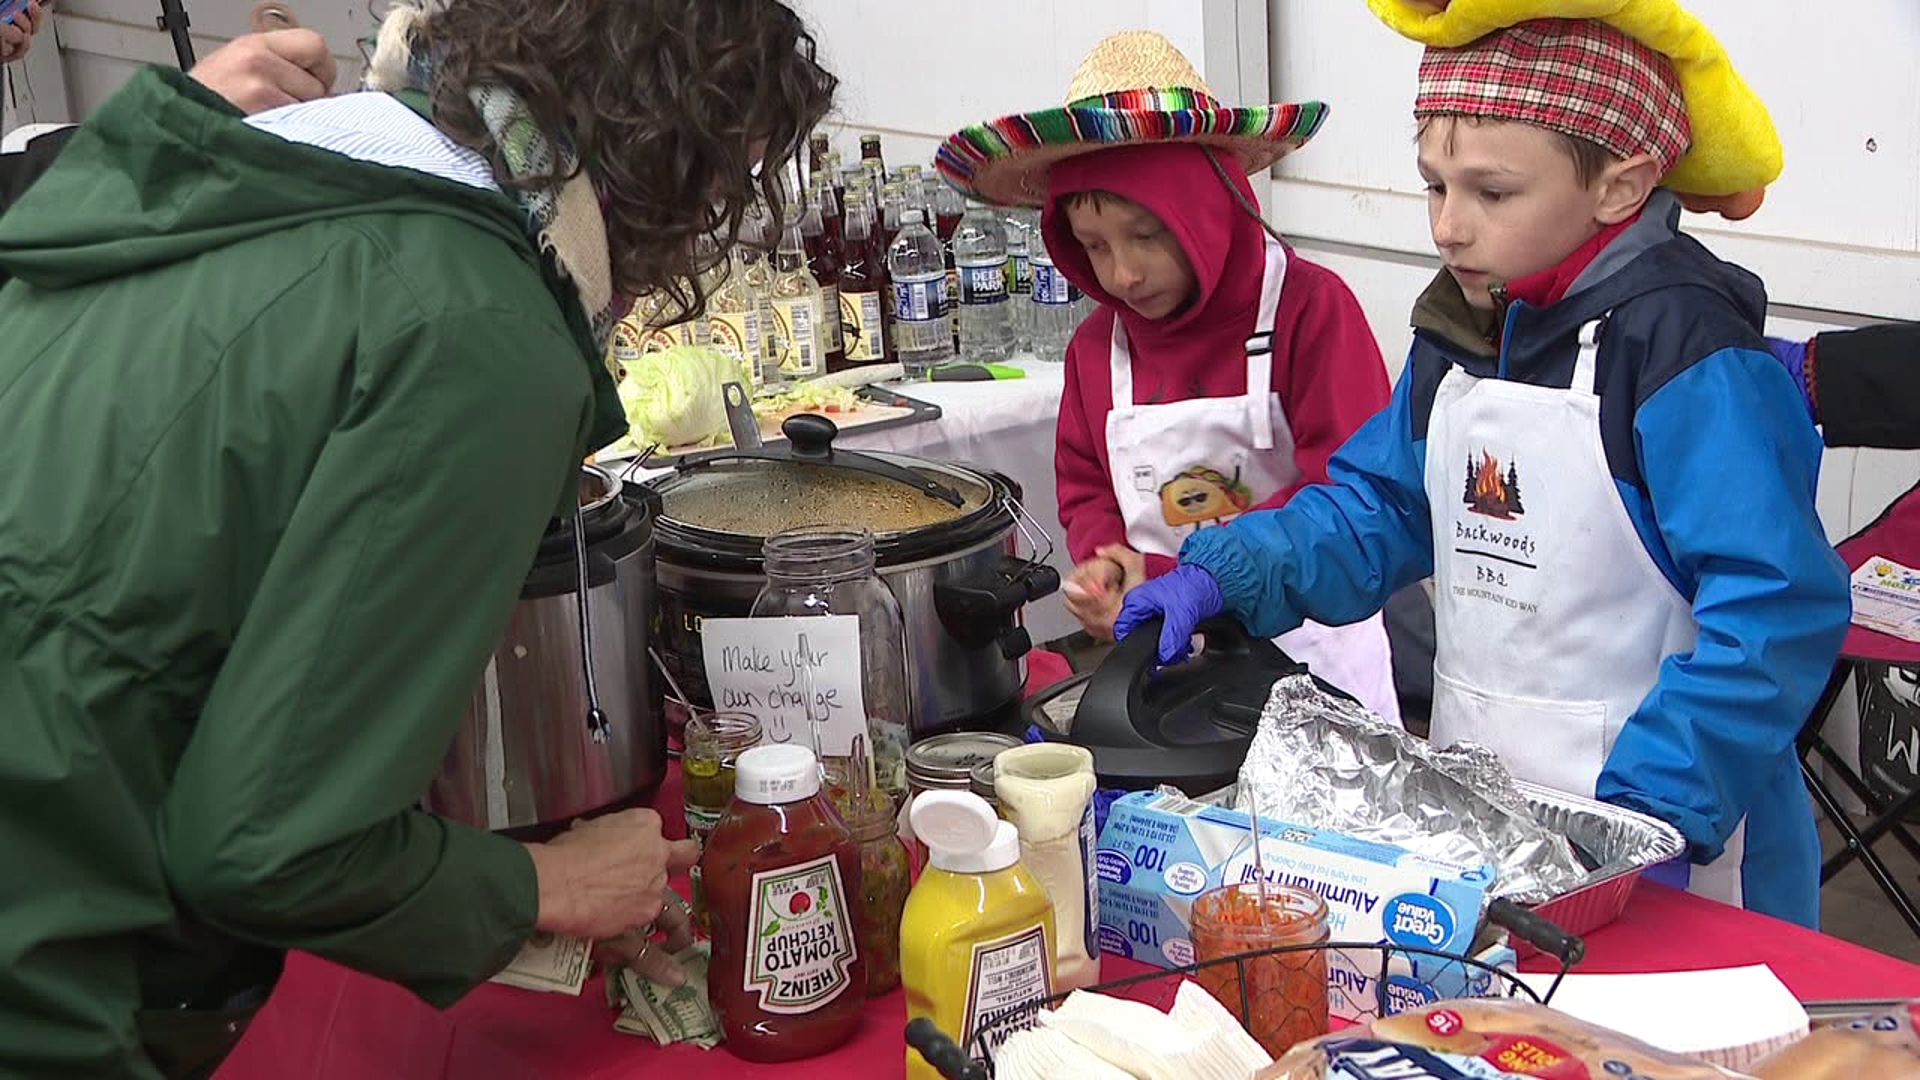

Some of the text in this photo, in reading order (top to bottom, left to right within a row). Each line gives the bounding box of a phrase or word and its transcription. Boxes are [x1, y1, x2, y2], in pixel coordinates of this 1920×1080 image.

[1455, 520, 1536, 558] Backwoods
[1476, 565, 1508, 587] BBQ
[1453, 585, 1539, 614] THE MOUNTAIN KID WAY
[722, 645, 774, 673] Make
[767, 682, 843, 722] chage
[1134, 845, 1167, 873] 100
[1397, 901, 1435, 921] Value
[766, 920, 836, 952] KETCHUP
[1128, 919, 1159, 948] 100
[1392, 914, 1445, 944] Great
[764, 935, 841, 972] TOMATO
[778, 967, 835, 998] HEINZ
[1387, 984, 1426, 1005] Value
[1428, 1013, 1453, 1034] 16
